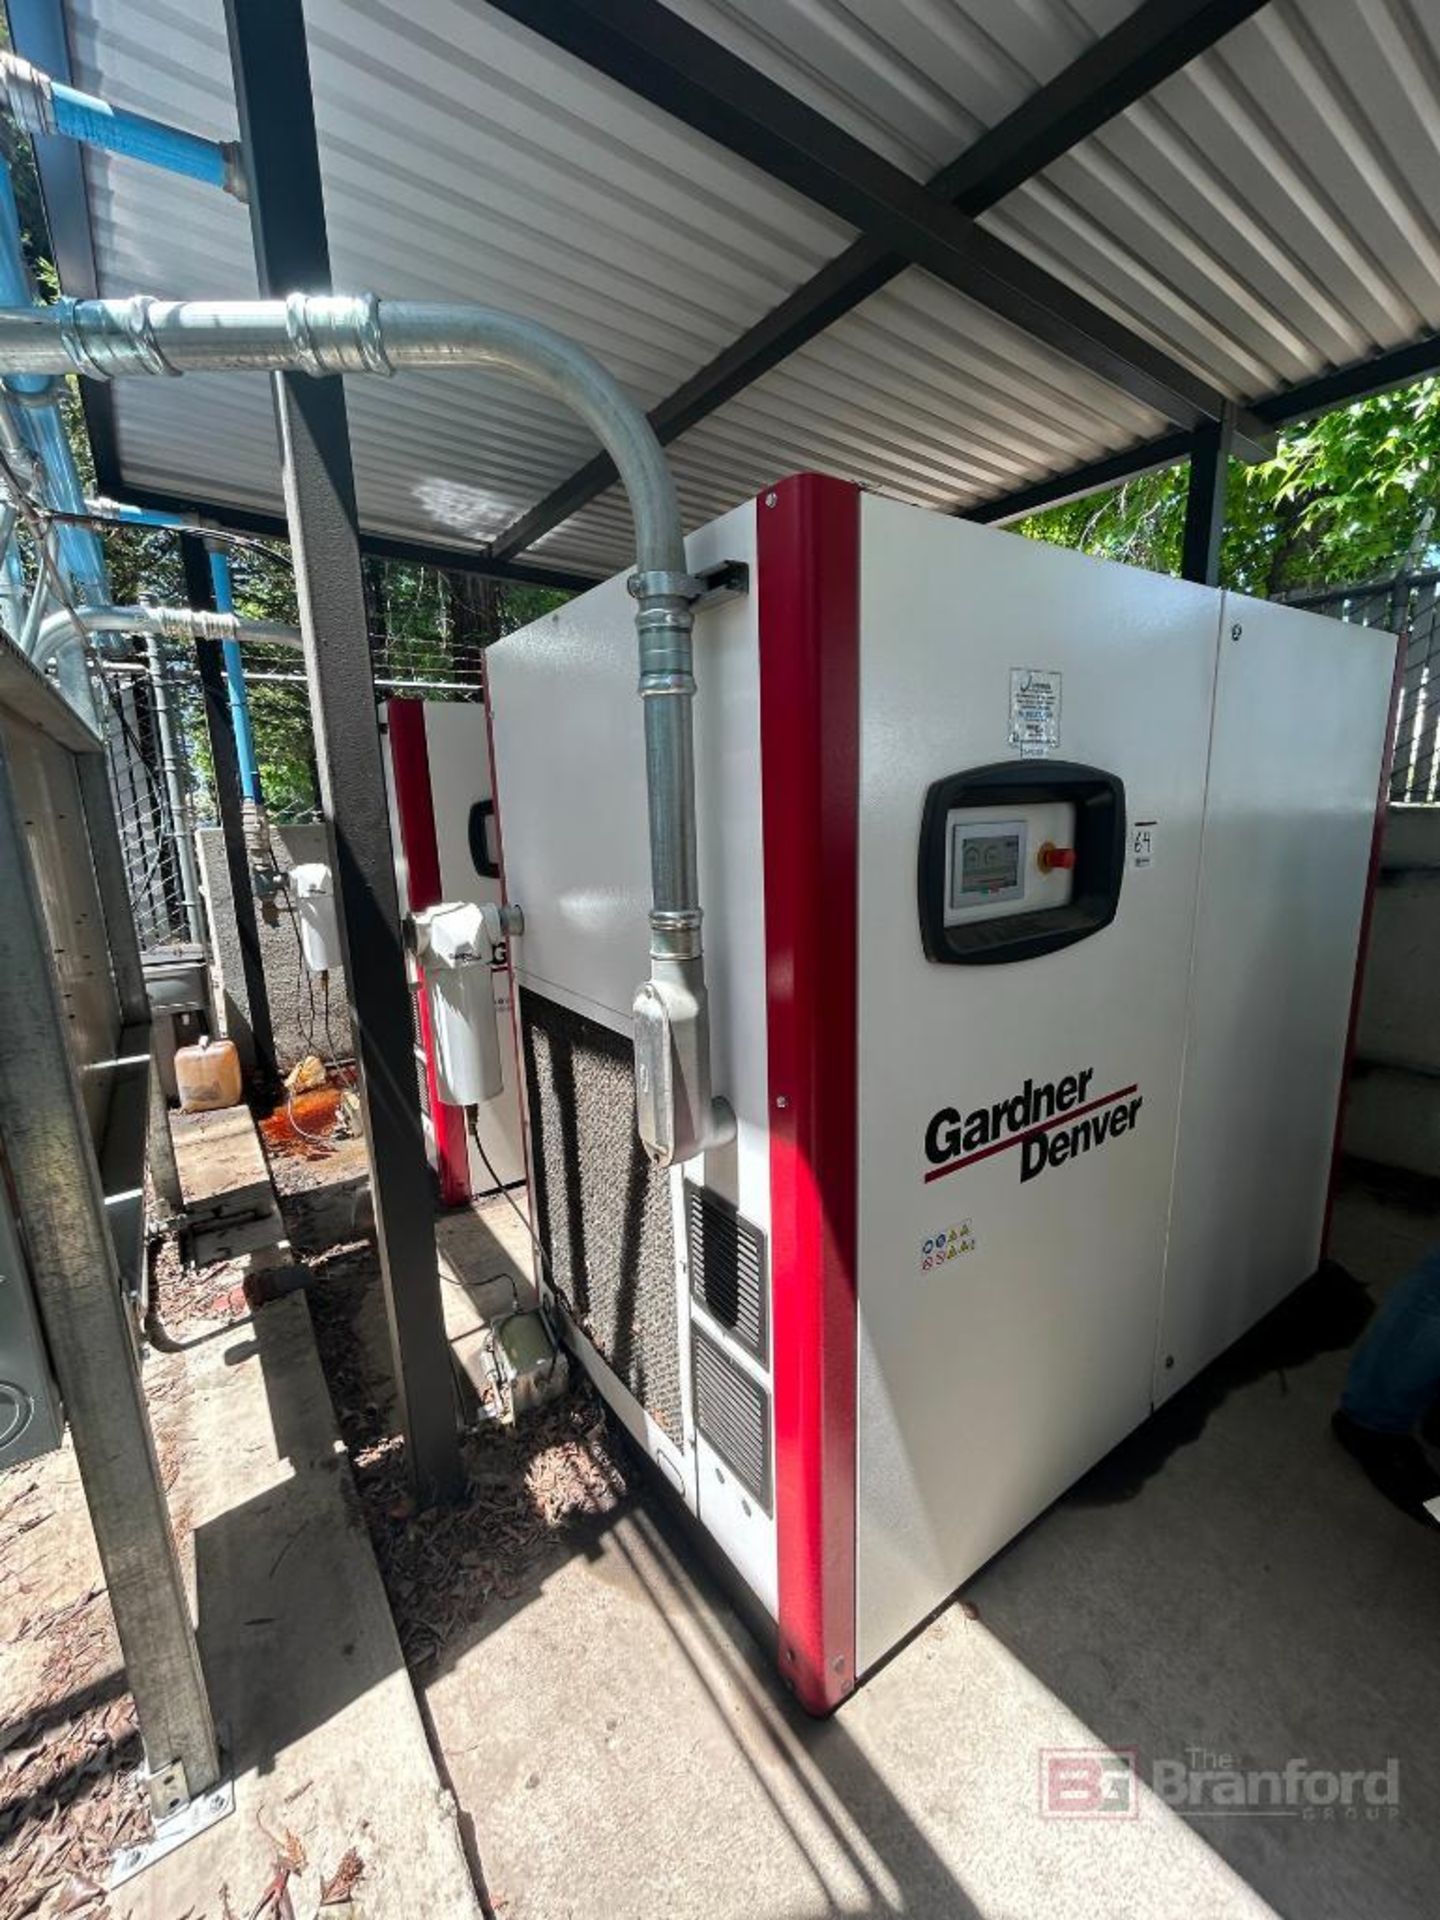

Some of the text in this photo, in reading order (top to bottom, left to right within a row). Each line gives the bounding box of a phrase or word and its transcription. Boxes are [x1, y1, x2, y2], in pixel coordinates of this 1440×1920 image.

[1134, 831, 1151, 853] 64
[924, 1067, 1094, 1163] Gardner
[1020, 1096, 1143, 1183] Denver
